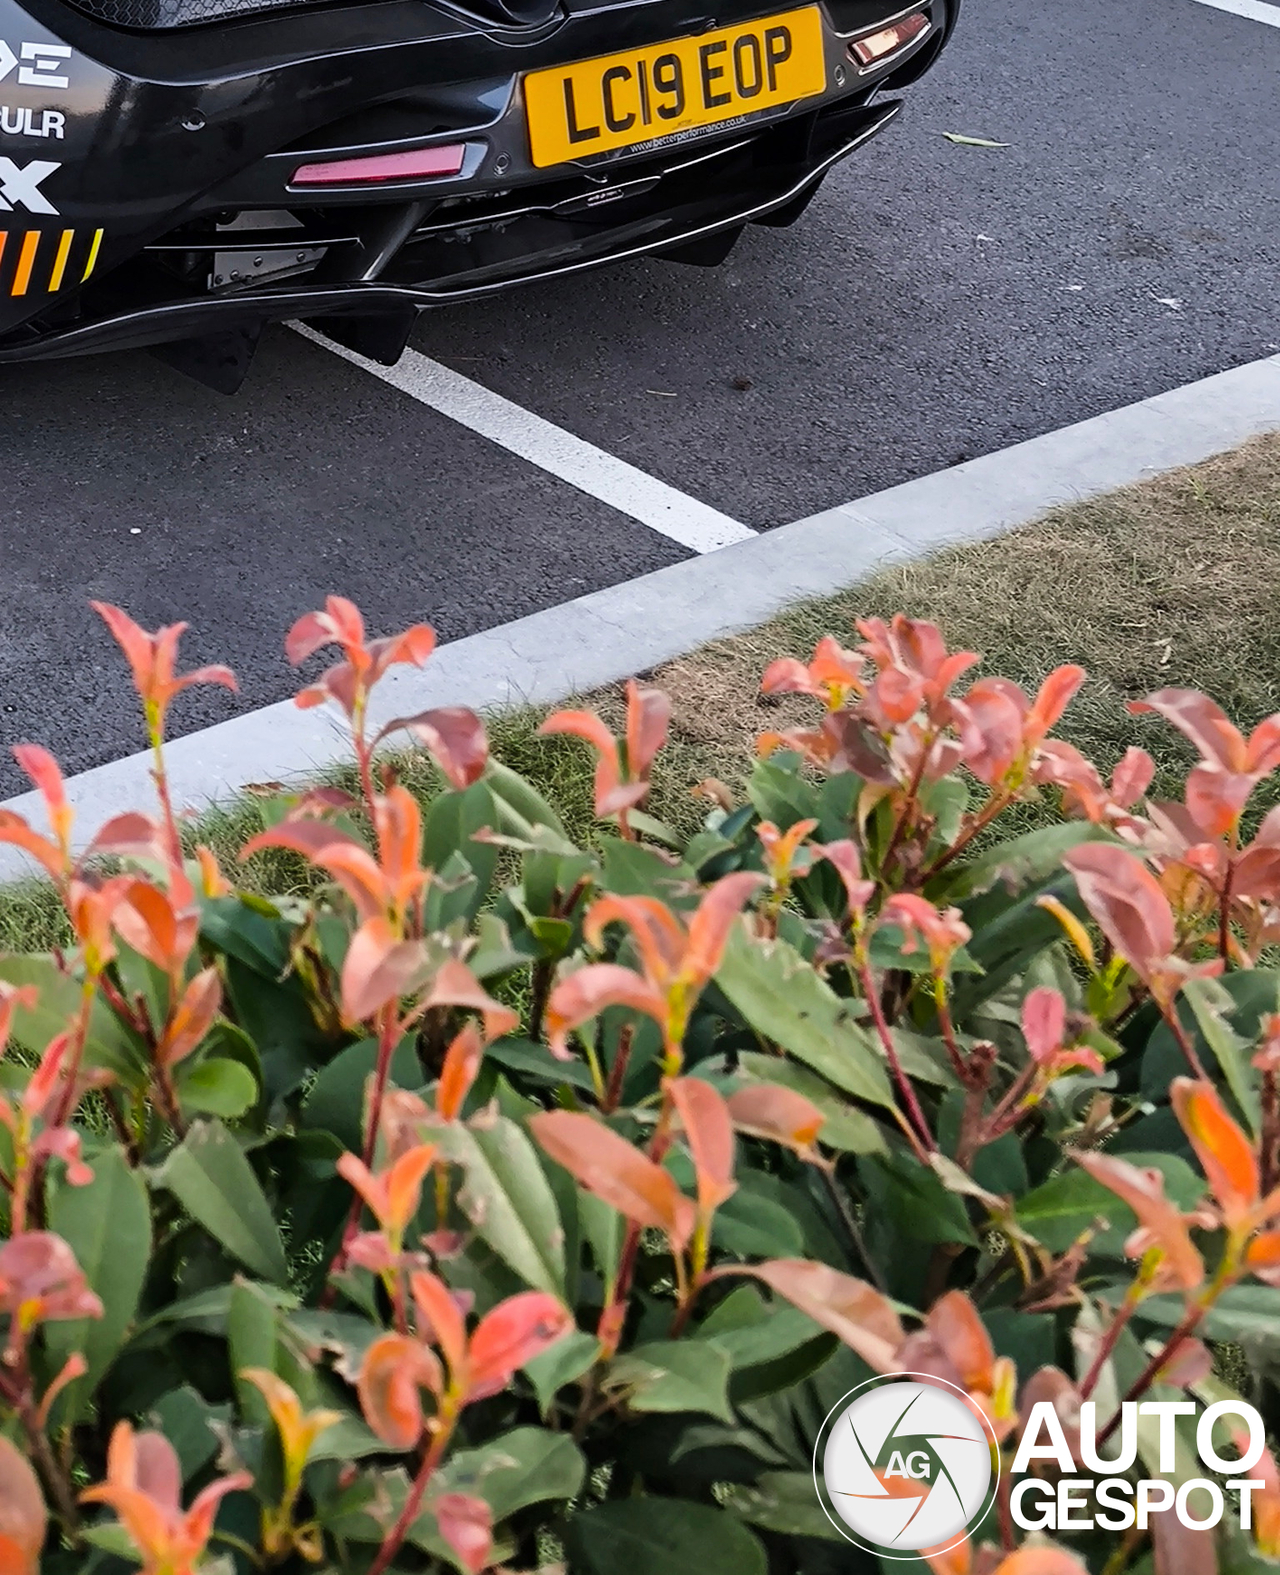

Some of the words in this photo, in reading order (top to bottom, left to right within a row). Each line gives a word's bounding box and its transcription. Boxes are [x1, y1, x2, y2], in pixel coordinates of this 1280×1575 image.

[563, 53, 687, 145] LC19
[698, 25, 793, 110] EOP
[629, 114, 747, 153] www.betterperformance.co.uk
